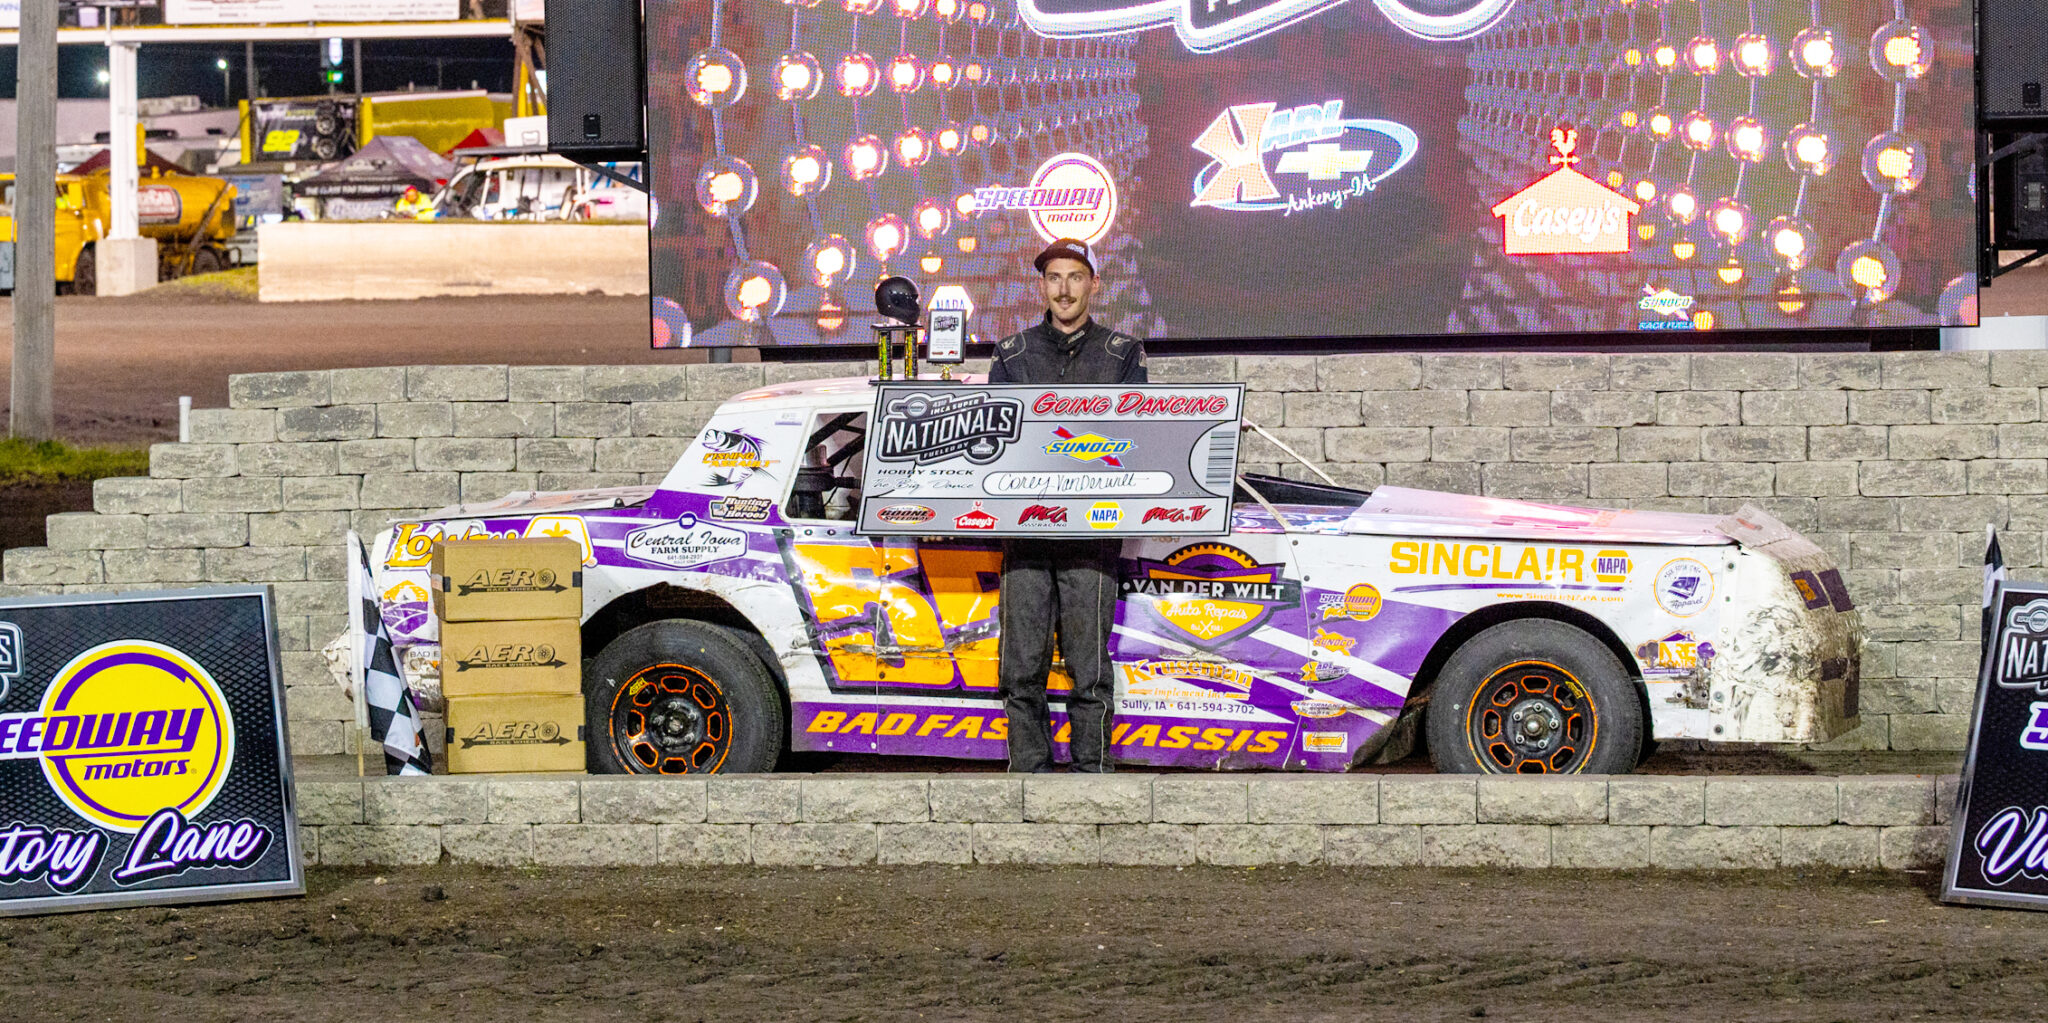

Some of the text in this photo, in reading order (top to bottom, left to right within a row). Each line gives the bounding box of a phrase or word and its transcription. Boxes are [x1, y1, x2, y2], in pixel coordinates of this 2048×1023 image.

[975, 188, 1104, 210] SPEEDWAY
[1047, 212, 1096, 222] motors
[1513, 199, 1620, 243] Casey's
[1643, 298, 1690, 308] SUNOCO
[930, 406, 950, 415] IMCA
[952, 399, 979, 410] SUPER
[1032, 391, 1229, 417] GOING DANCING
[886, 407, 1013, 453] NATIONALS
[923, 442, 969, 459] FUELED BY
[1049, 441, 1130, 453] SUNOCO
[996, 472, 1054, 501] Corey
[726, 497, 770, 507] Hunting
[725, 510, 767, 518] Heroes
[958, 515, 994, 529] Casey's
[1091, 510, 1119, 521] NAPA
[631, 531, 742, 548] Central Iowa
[1389, 541, 1585, 583] SINCLAIR
[1598, 557, 1627, 574] NAPA
[465, 568, 556, 588] AERO
[1133, 579, 1284, 600] VAN DER WILT
[1320, 594, 1378, 606] SPEEDWAY
[1167, 603, 1201, 617] Auto
[1315, 638, 1353, 647] SUNOCO
[463, 643, 556, 664] AERO
[1121, 658, 1253, 688] Kruseman
[1154, 687, 1204, 699] Implement
[1122, 700, 1255, 714] Sully, IA 641-594-3702
[467, 721, 560, 740] AERO
[806, 710, 914, 736] BAD
[84, 759, 190, 781] motors
[116, 811, 264, 878] Lane
